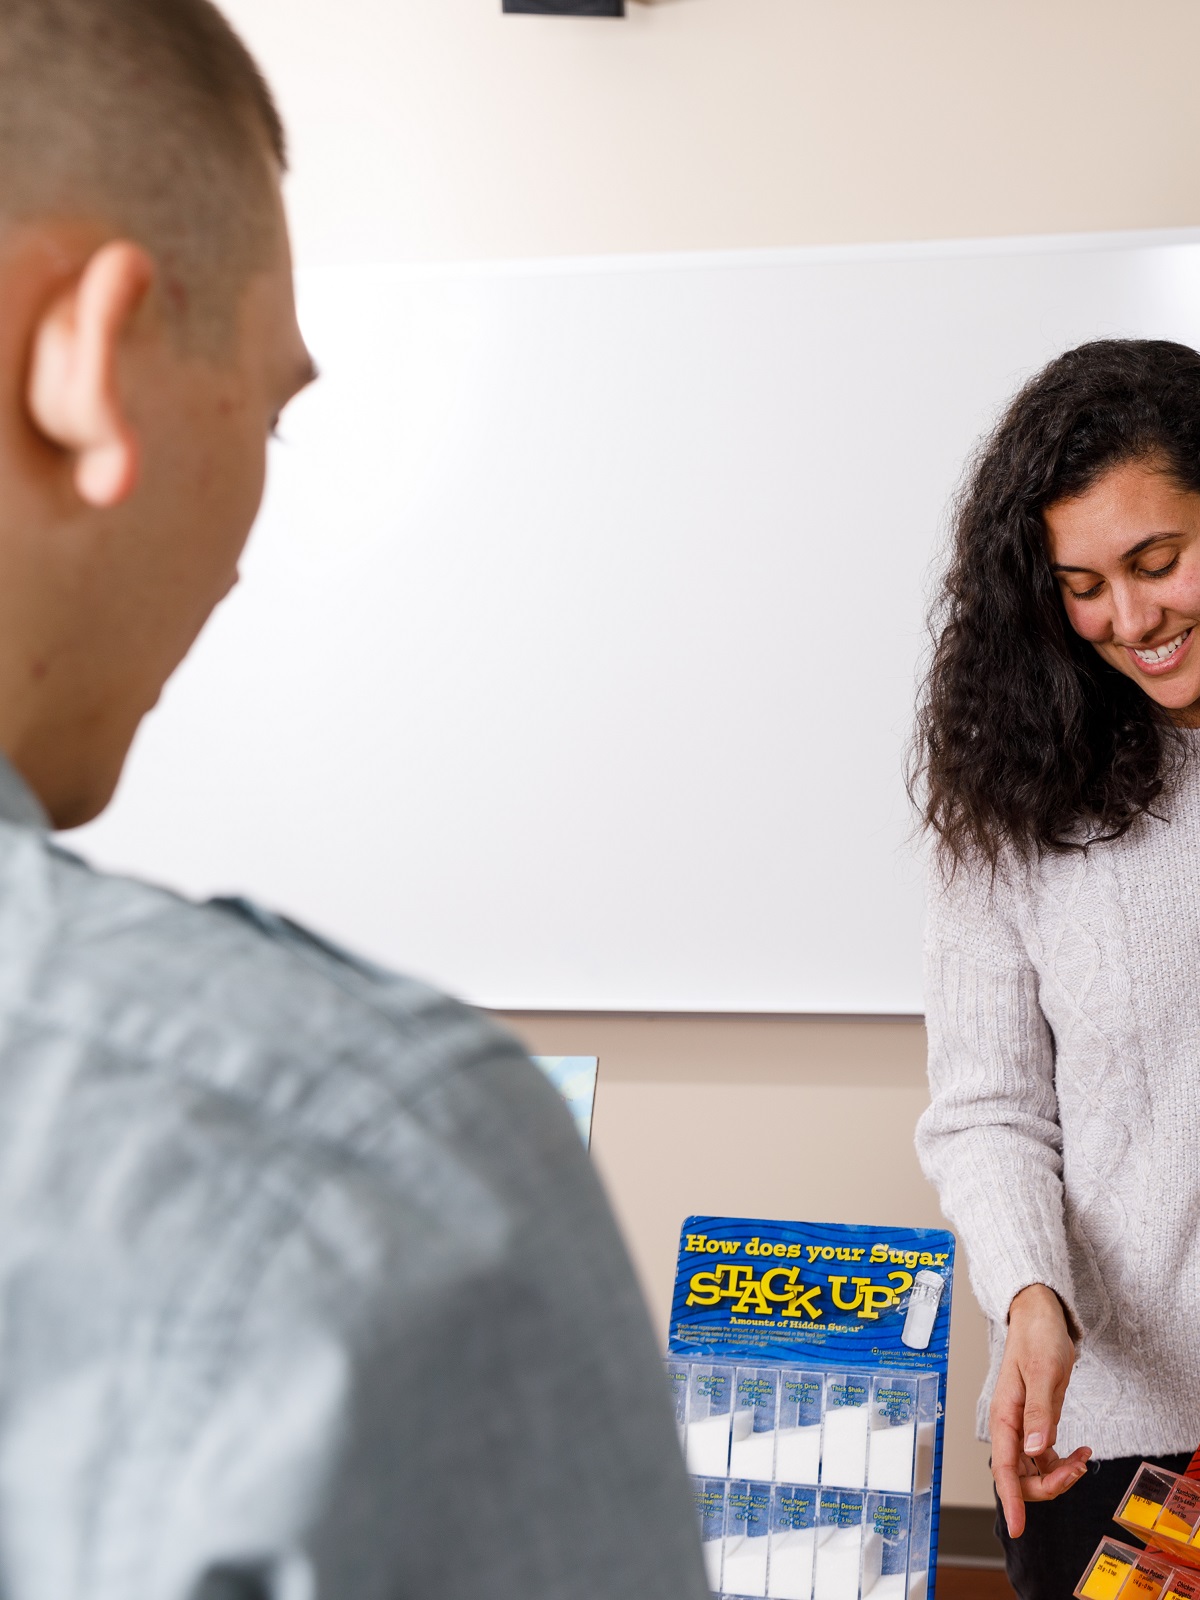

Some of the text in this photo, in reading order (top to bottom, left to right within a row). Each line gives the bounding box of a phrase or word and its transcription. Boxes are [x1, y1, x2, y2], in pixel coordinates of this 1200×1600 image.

[685, 1234, 948, 1269] How does your Sugar
[685, 1264, 913, 1320] STACK UP?
[729, 1317, 776, 1327] Amounts
[777, 1320, 788, 1328] of
[790, 1320, 826, 1330] Hidden
[1150, 1569, 1164, 1580] Potato
[1177, 1581, 1196, 1593] Chicken
